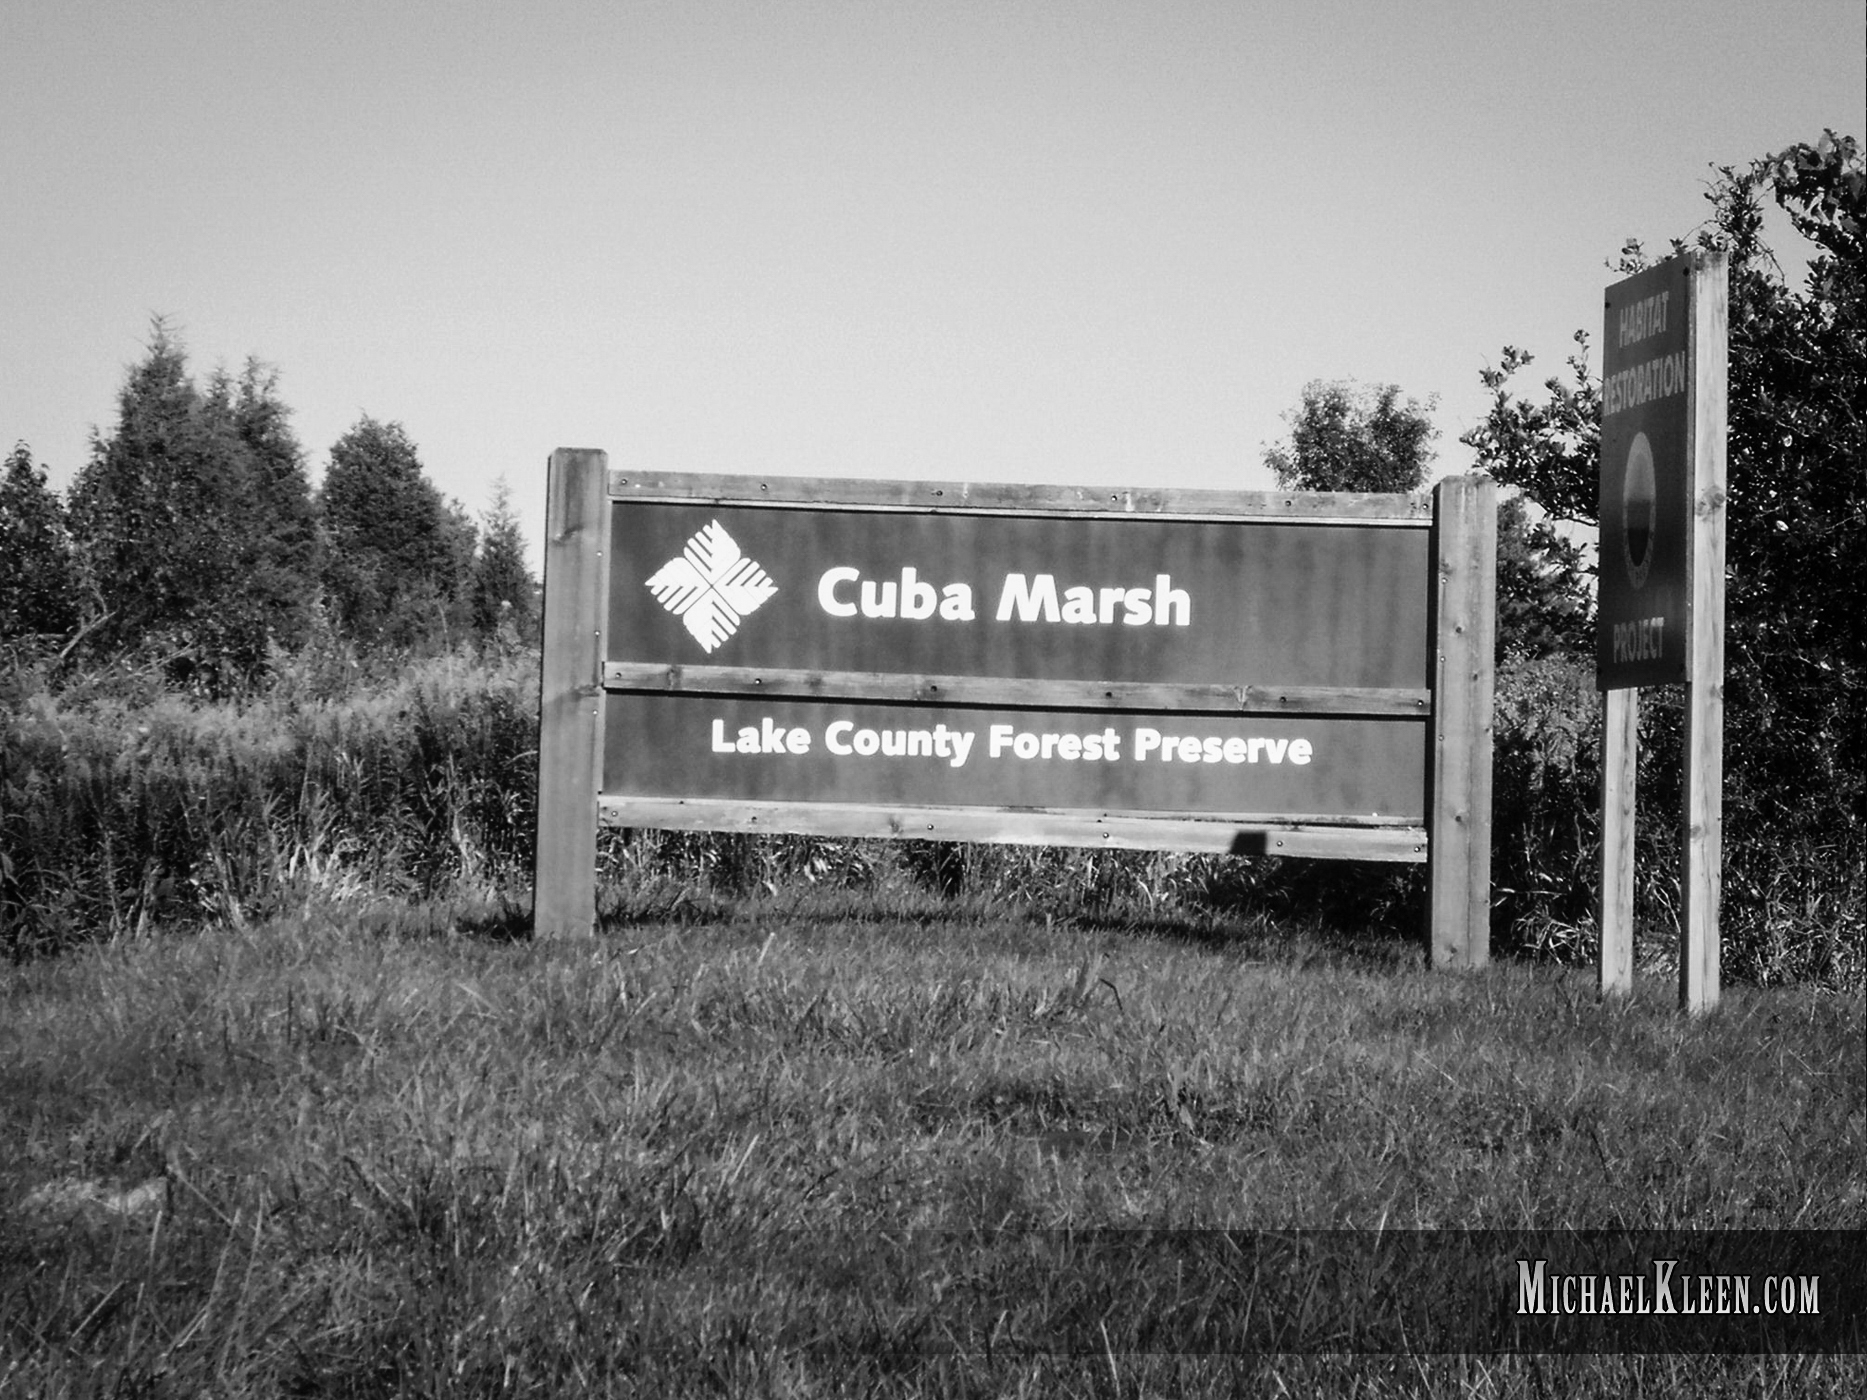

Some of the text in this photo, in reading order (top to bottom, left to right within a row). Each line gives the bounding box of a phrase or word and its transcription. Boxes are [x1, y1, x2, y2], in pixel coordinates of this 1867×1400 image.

[1619, 291, 1669, 348] HABITAT
[1602, 351, 1685, 416] RESTORATION
[818, 567, 1190, 626] Cuba Marsh
[1613, 617, 1664, 663] PROJECT
[712, 718, 1312, 767] Lake County Forest Preserve
